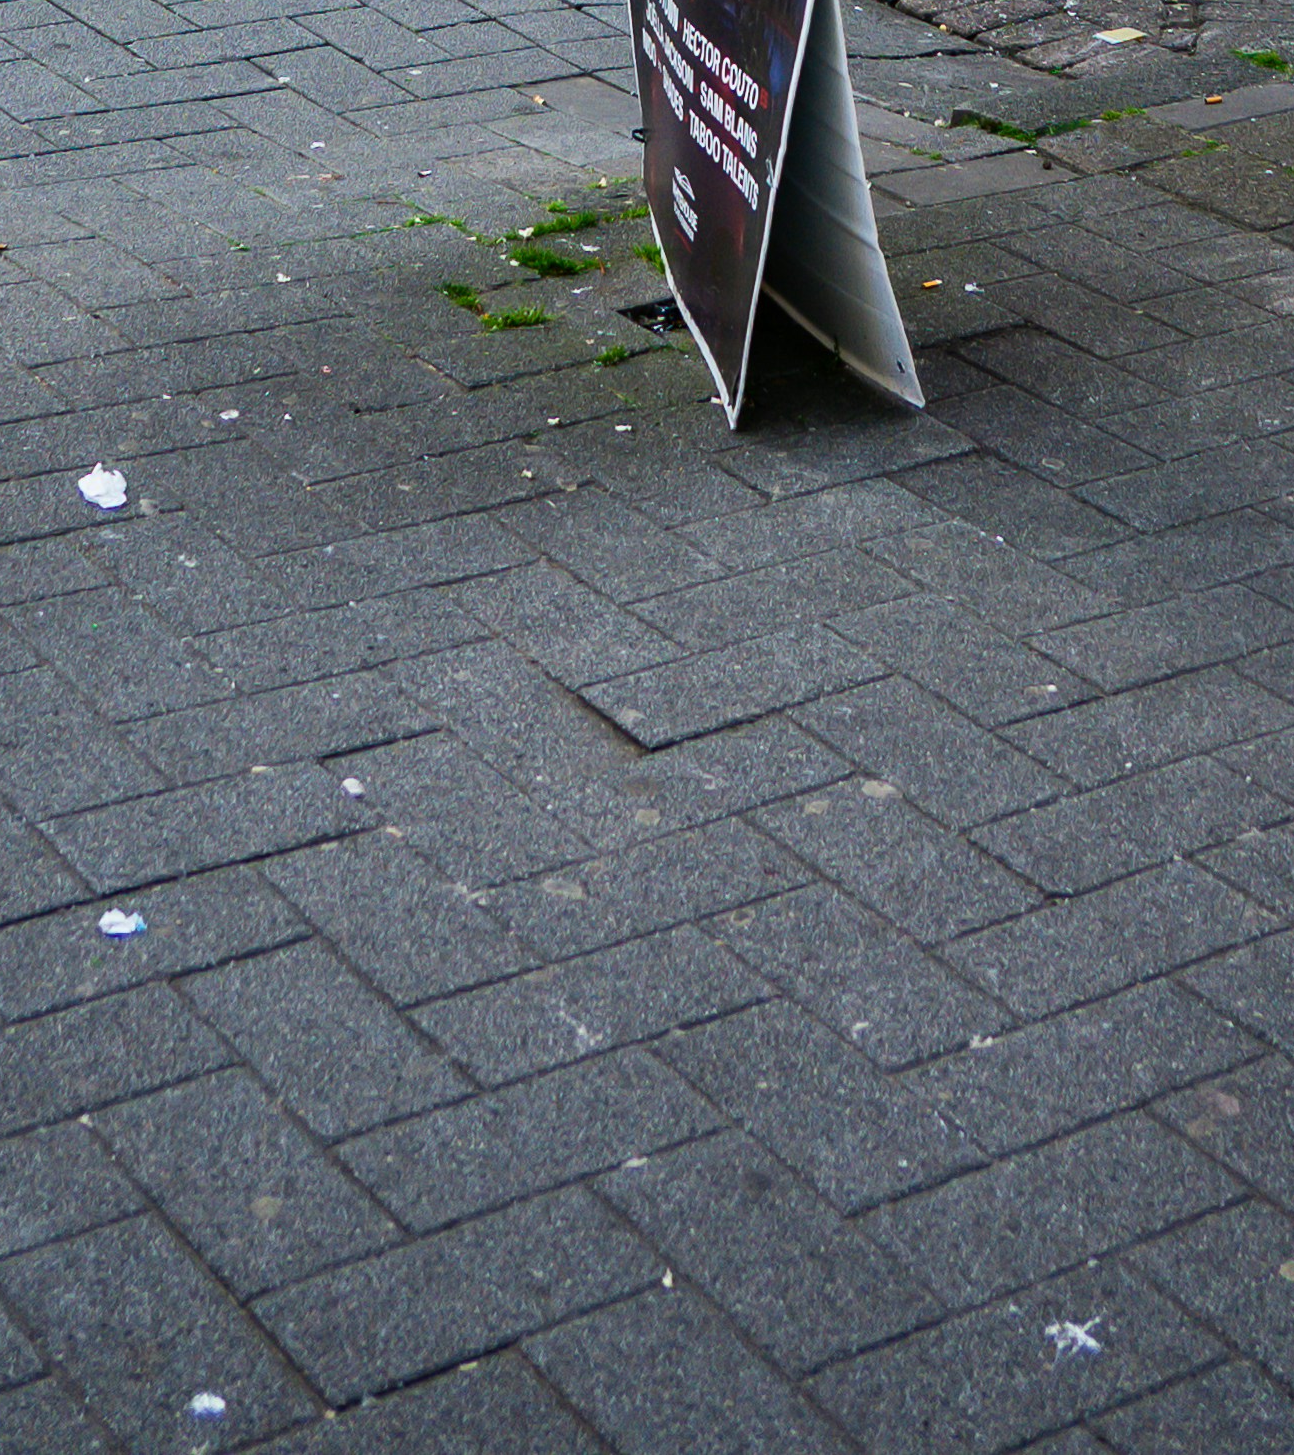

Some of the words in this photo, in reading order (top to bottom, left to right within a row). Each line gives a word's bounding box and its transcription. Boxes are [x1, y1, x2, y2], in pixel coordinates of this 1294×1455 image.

[682, 17, 721, 78] HECTOR
[721, 56, 759, 111] COUTO
[689, 108, 721, 163] TABOO
[721, 143, 759, 212] TALENTS
[699, 80, 724, 125] SAM
[724, 103, 758, 160] BLANS
